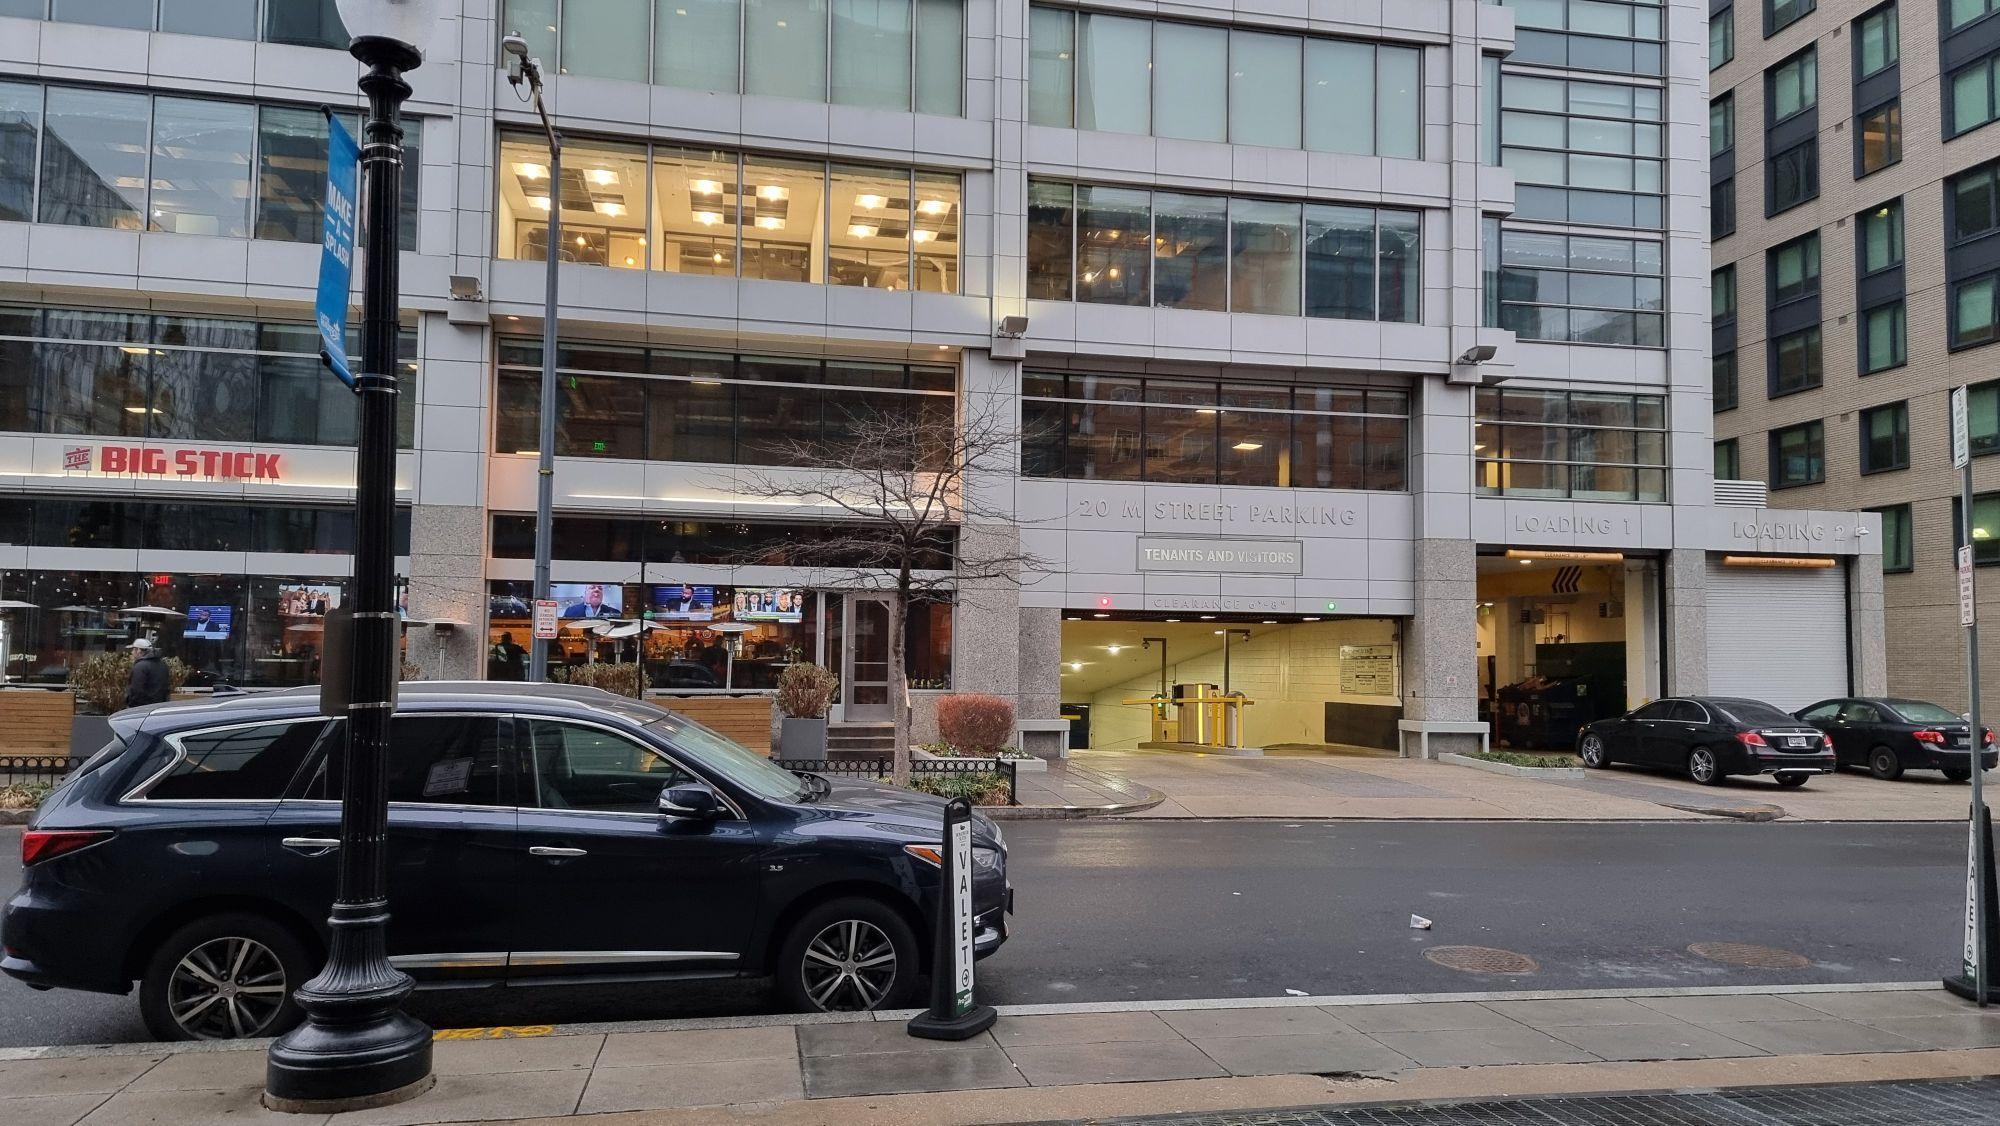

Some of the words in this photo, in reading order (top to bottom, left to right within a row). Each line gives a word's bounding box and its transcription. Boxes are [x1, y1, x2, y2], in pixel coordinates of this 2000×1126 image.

[328, 180, 353, 228] MAKE
[335, 219, 342, 238] A
[325, 230, 350, 269] SPLASH
[66, 452, 89, 464] THE
[101, 446, 167, 475] BIG
[175, 449, 281, 479] STICK
[1079, 499, 1111, 518] 20
[1121, 501, 1142, 519] M
[1154, 501, 1239, 522] STREET
[1249, 504, 1356, 527] PARKING
[1514, 514, 1611, 535] LOADING
[1622, 518, 1632, 536] 1
[1732, 520, 1826, 542] LOADING
[1834, 525, 1846, 543] 2
[1144, 548, 1203, 563] TENANTS
[1207, 549, 1235, 563] AND
[1238, 550, 1295, 565] VISITORS
[1153, 599, 1241, 610] CLEARANCE
[959, 850, 968, 965] VALET
